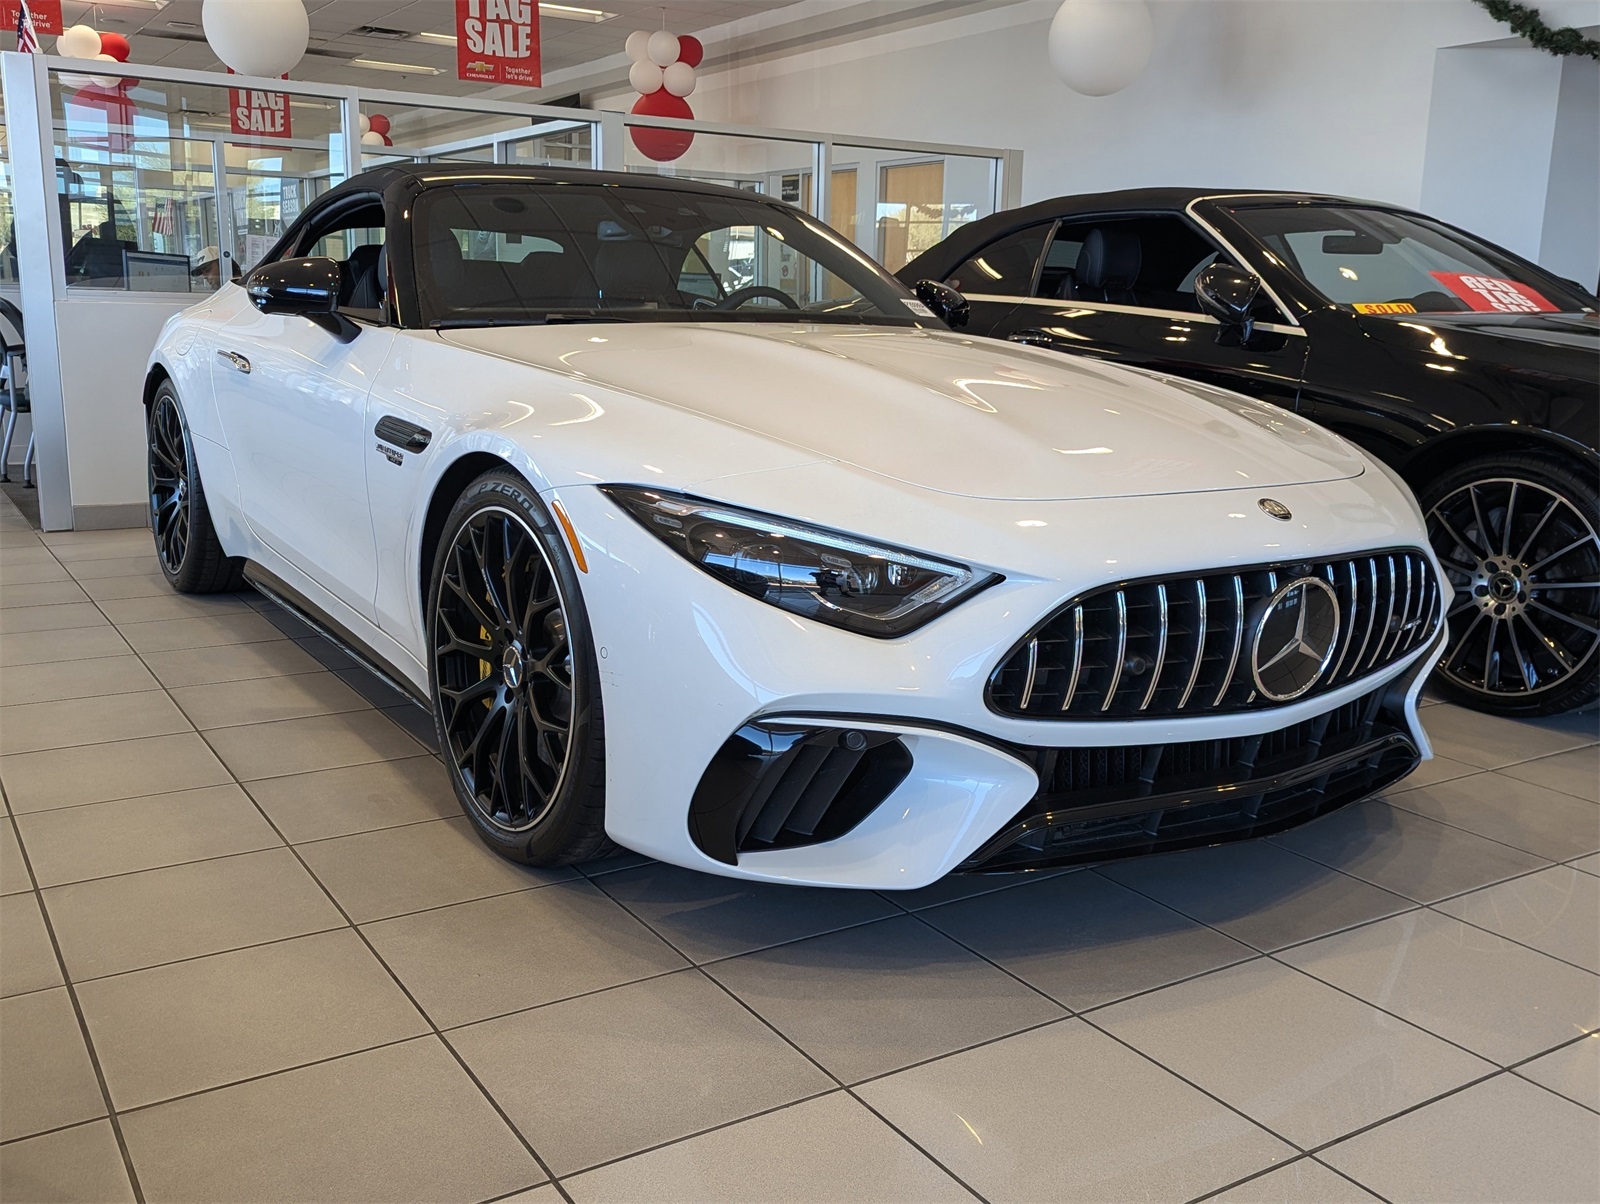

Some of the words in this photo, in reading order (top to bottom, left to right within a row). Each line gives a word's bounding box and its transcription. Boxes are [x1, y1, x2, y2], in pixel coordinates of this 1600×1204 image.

[11, 10, 47, 20] Tother
[464, 18, 532, 59] SALE
[466, 72, 496, 80] CHEVROLET
[505, 65, 531, 75] Together
[236, 106, 285, 132] SALE
[1459, 275, 1518, 294] RED
[1472, 288, 1538, 309] TAG
[478, 483, 489, 494] P
[490, 482, 534, 512] ZERO
